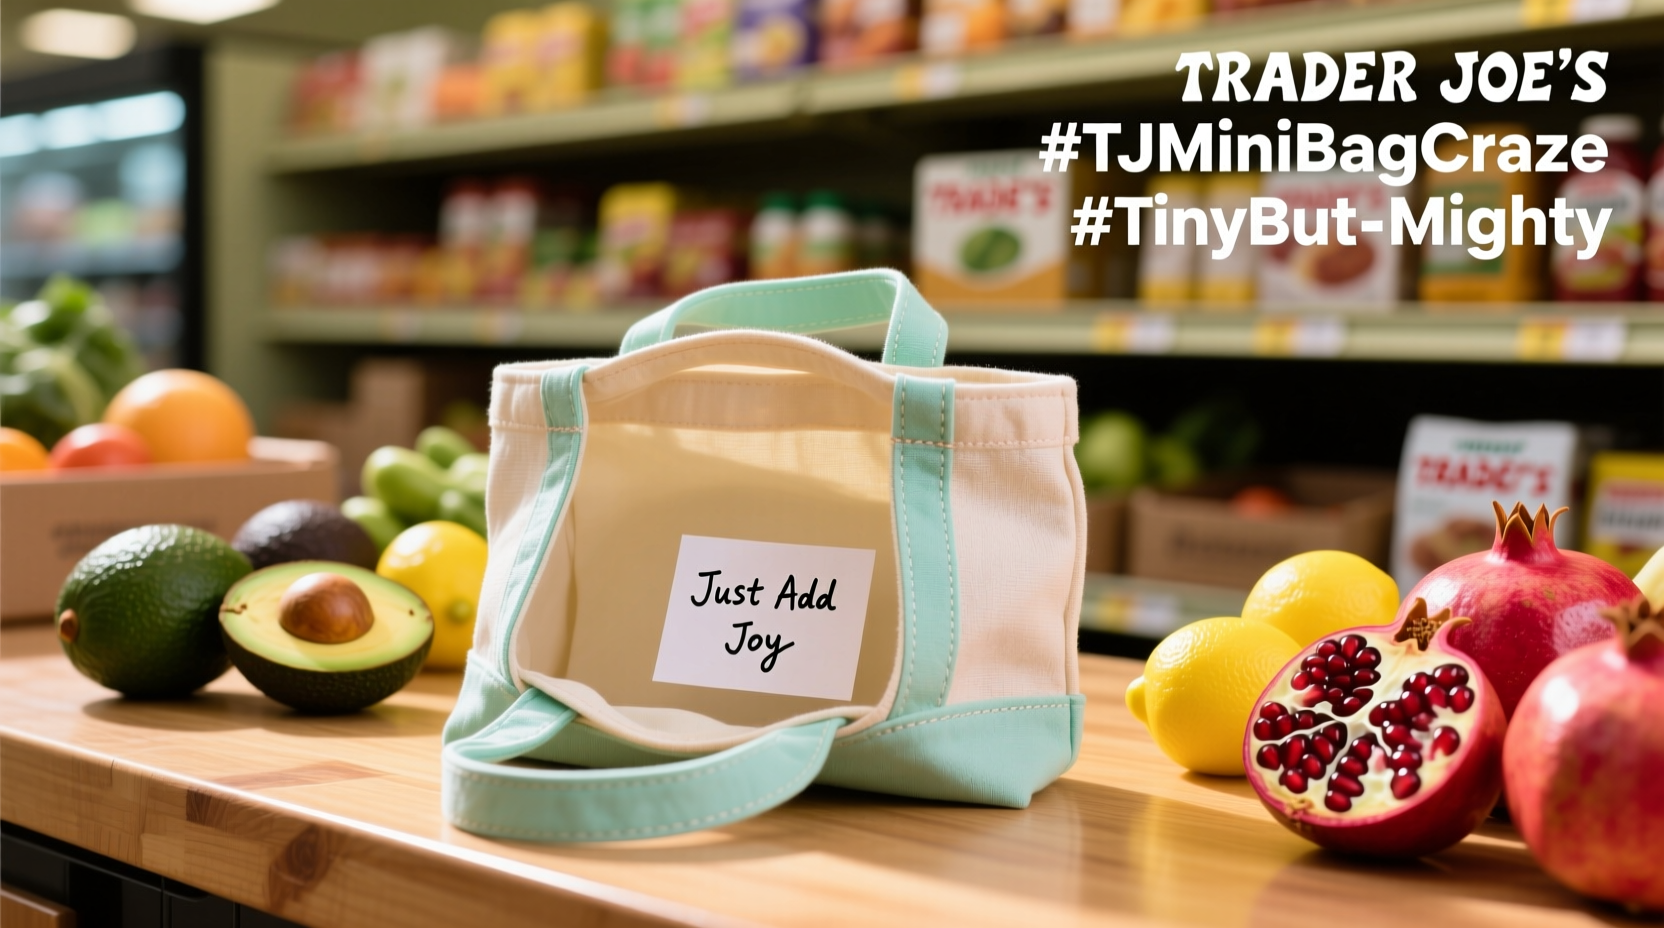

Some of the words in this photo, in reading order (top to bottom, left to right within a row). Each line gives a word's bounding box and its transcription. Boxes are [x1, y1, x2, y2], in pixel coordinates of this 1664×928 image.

[690, 569, 765, 607] Just
[773, 574, 837, 611] Add
[724, 620, 795, 673] Joy
